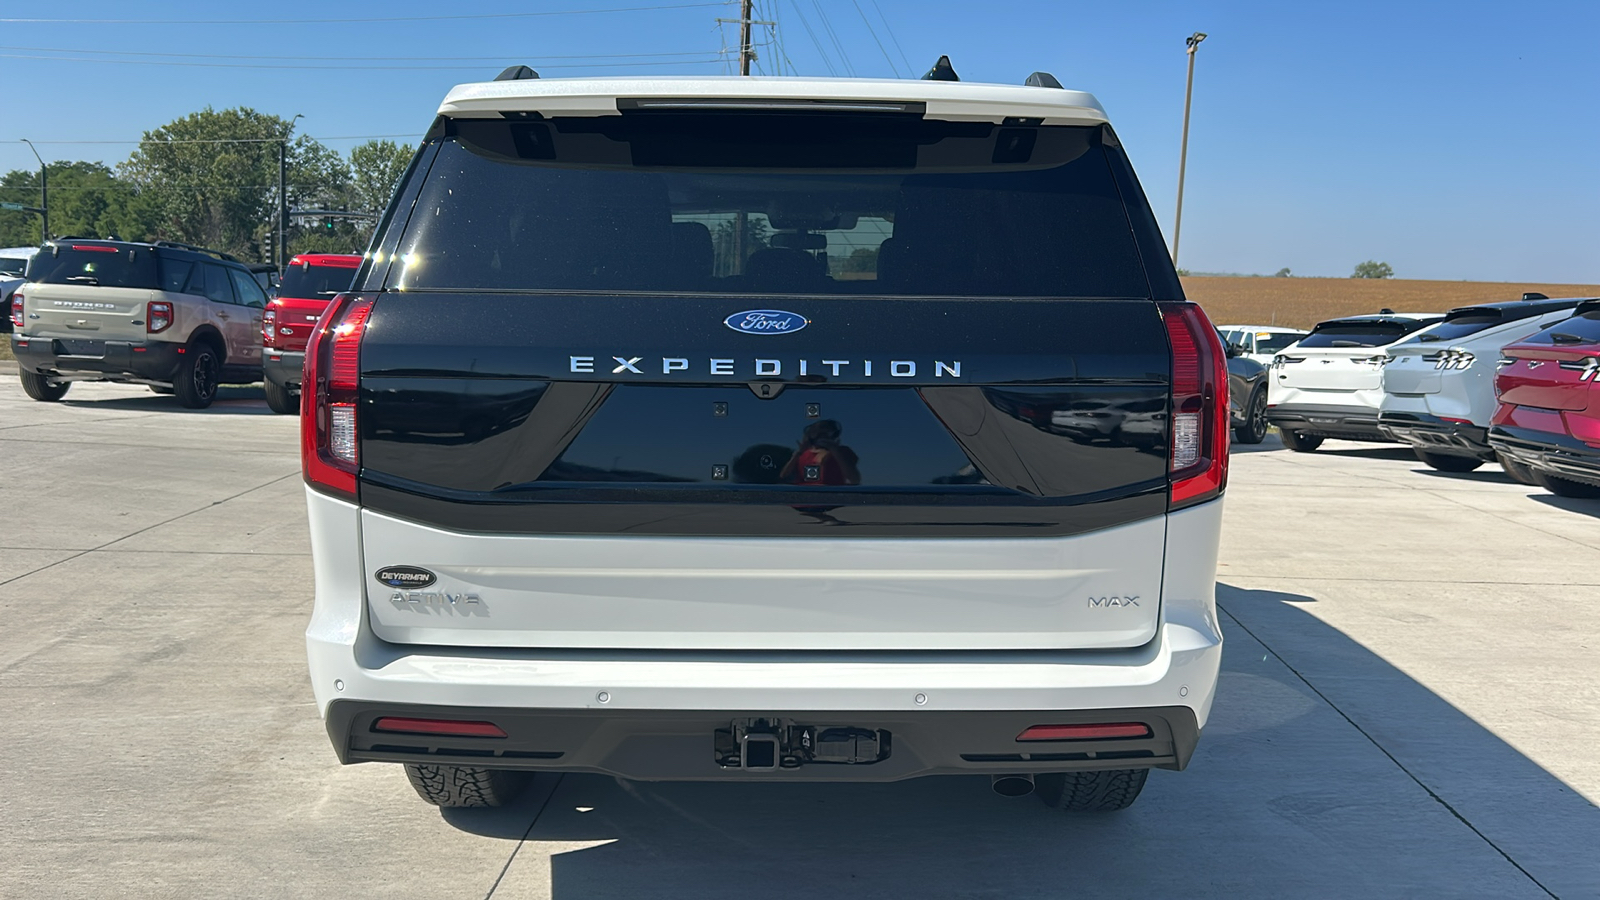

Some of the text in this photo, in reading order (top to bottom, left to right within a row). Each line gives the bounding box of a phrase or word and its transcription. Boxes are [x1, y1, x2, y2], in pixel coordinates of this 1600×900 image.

[53, 300, 116, 309] BRONCO
[740, 312, 792, 330] Ford
[569, 355, 962, 378] EXPEDITION
[381, 572, 430, 581] DEYARMAN
[389, 592, 480, 605] ACTIVE
[1087, 596, 1140, 608] MAX
